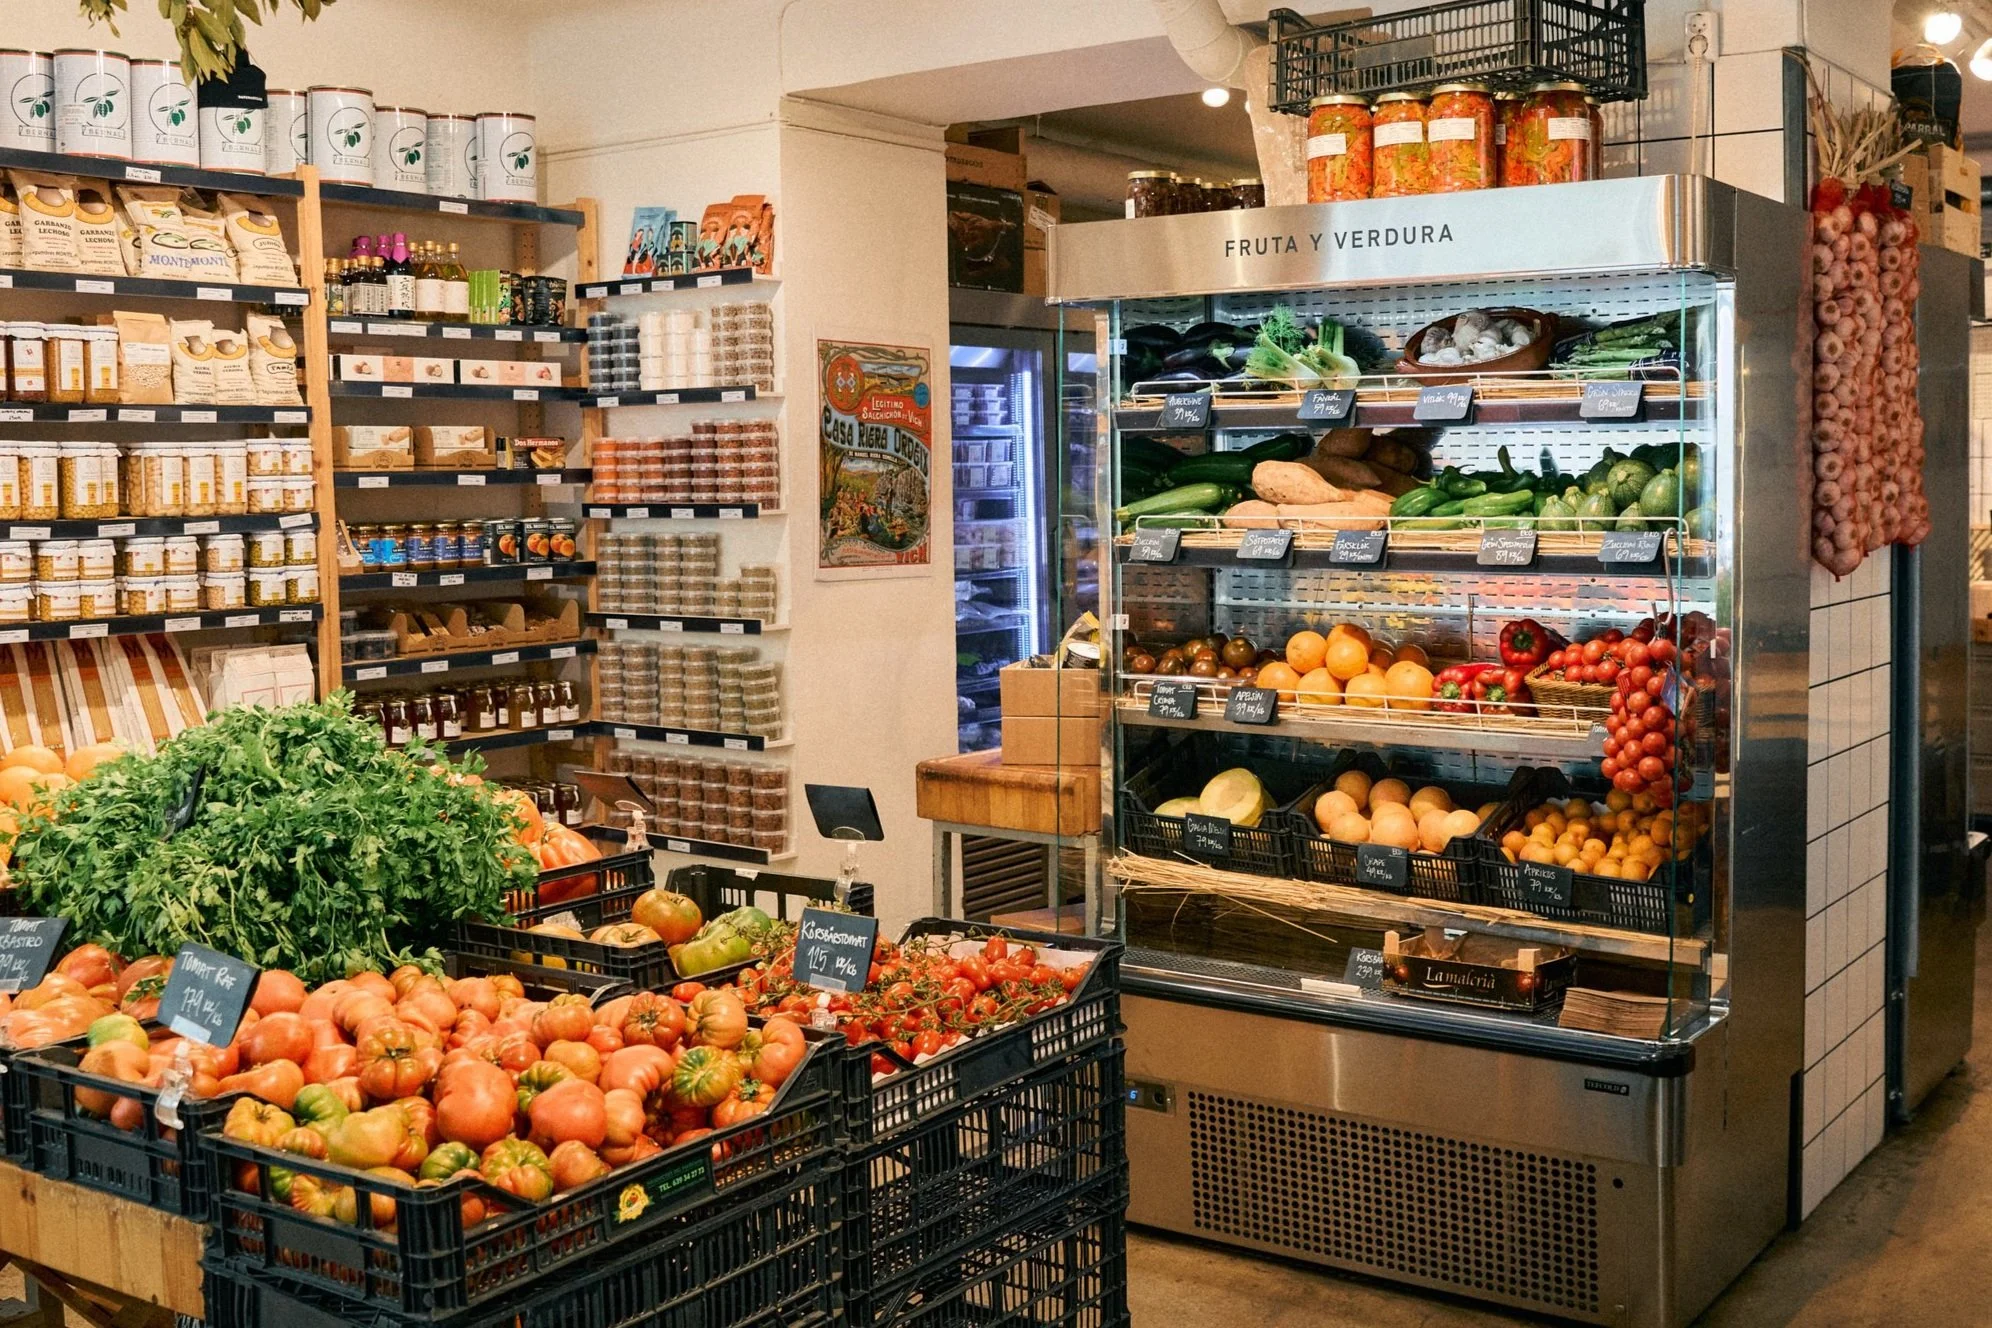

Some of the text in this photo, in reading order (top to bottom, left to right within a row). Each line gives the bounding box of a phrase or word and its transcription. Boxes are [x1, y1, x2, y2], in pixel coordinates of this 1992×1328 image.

[1225, 224, 1454, 257] FRUTA Y VERDURA
[514, 438, 559, 447] Dos Hermanos
[858, 422, 888, 450] RIERA
[896, 542, 928, 563] VICH
[181, 951, 217, 980] TOMAT
[808, 945, 829, 972] 125
[1426, 966, 1443, 982] La
